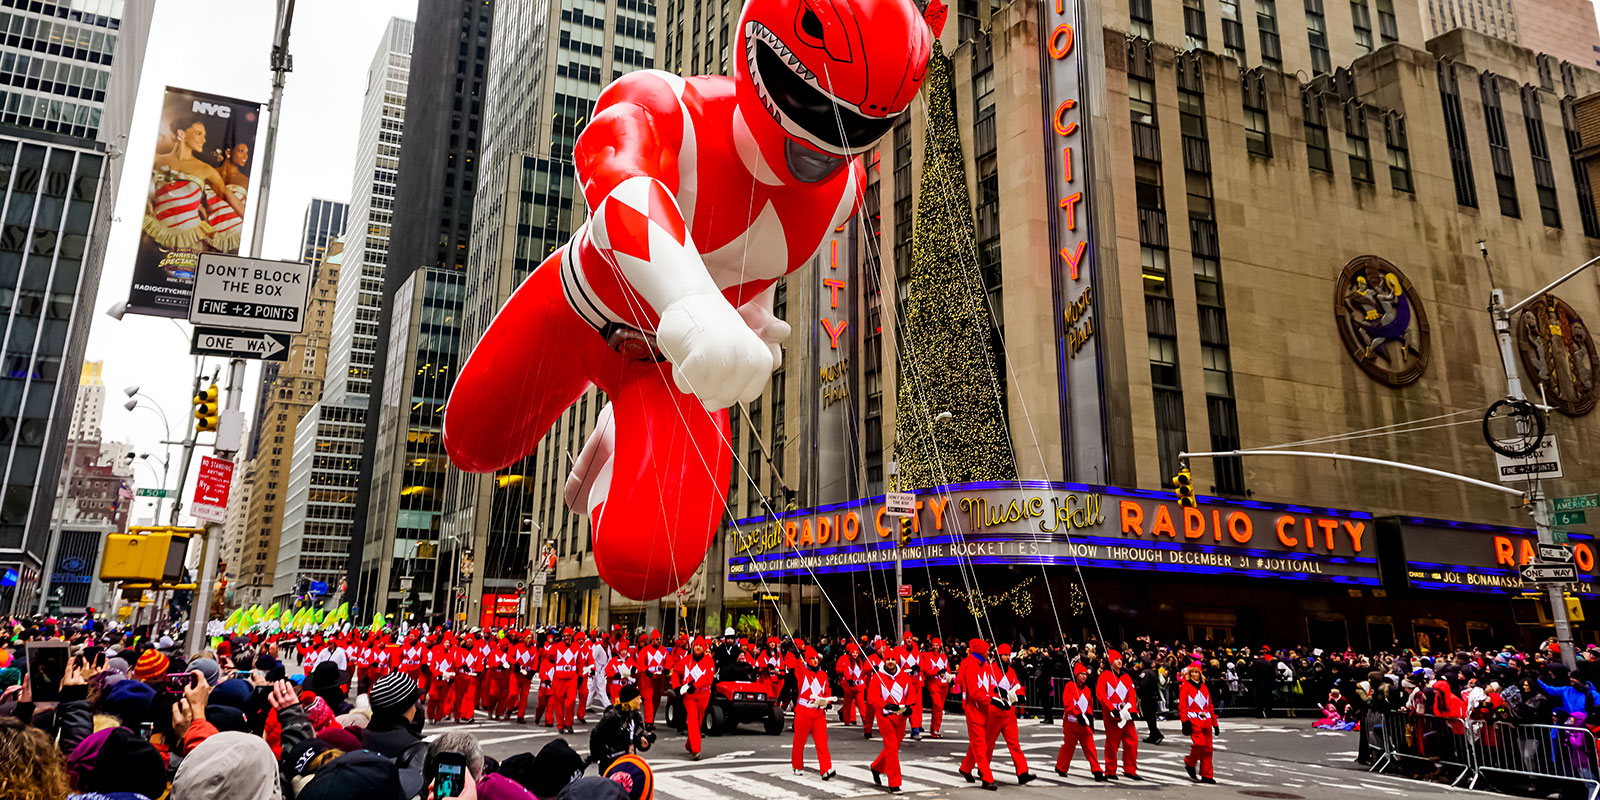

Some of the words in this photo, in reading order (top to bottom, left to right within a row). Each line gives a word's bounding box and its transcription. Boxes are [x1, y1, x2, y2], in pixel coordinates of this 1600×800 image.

[192, 100, 231, 119] NYC
[1054, 99, 1086, 280] CITY
[205, 264, 249, 278] DON'T
[253, 269, 301, 284] BLOCK
[222, 281, 250, 293] THE
[254, 284, 283, 296] BOX
[820, 225, 848, 350] ITY
[201, 300, 228, 314] FINE
[232, 304, 251, 316] +2
[254, 306, 295, 320] POINTS
[205, 336, 234, 349] ONE
[246, 340, 275, 352] WAY
[202, 459, 210, 467] NO
[210, 461, 232, 472] STANDING
[207, 469, 225, 477] ANYTIME
[1502, 466, 1517, 474] FINE
[147, 489, 158, 497] 50
[960, 497, 1043, 530] Music
[1040, 493, 1105, 532] Hall
[1556, 499, 1598, 510] AMERICAS
[785, 511, 859, 548] RADIO
[875, 496, 948, 537] CTY
[1120, 500, 1253, 543] RADIO
[1276, 514, 1365, 552] CITY
[1562, 513, 1570, 524] 6
[749, 560, 767, 572] RADIO
[770, 559, 784, 570] CITY
[786, 556, 822, 569] CHRISTMAS
[825, 550, 877, 566] SPECTACULAR
[882, 547, 922, 560] STARING
[927, 545, 943, 557] THE
[1069, 544, 1097, 557] NOW
[1106, 546, 1163, 562] THROUGH
[1170, 551, 1232, 567] DECEMBER
[1240, 556, 1250, 568] 31
[1257, 558, 1322, 574] #JOYTOALL
[1493, 536, 1594, 572] RAO
[1541, 548, 1554, 557] ONE
[1443, 571, 1462, 583] JOE
[1467, 573, 1525, 588] BONAMASSA
[1525, 569, 1544, 577] ONE
[1552, 569, 1571, 577] WAY
[295, 747, 316, 773] NYC
